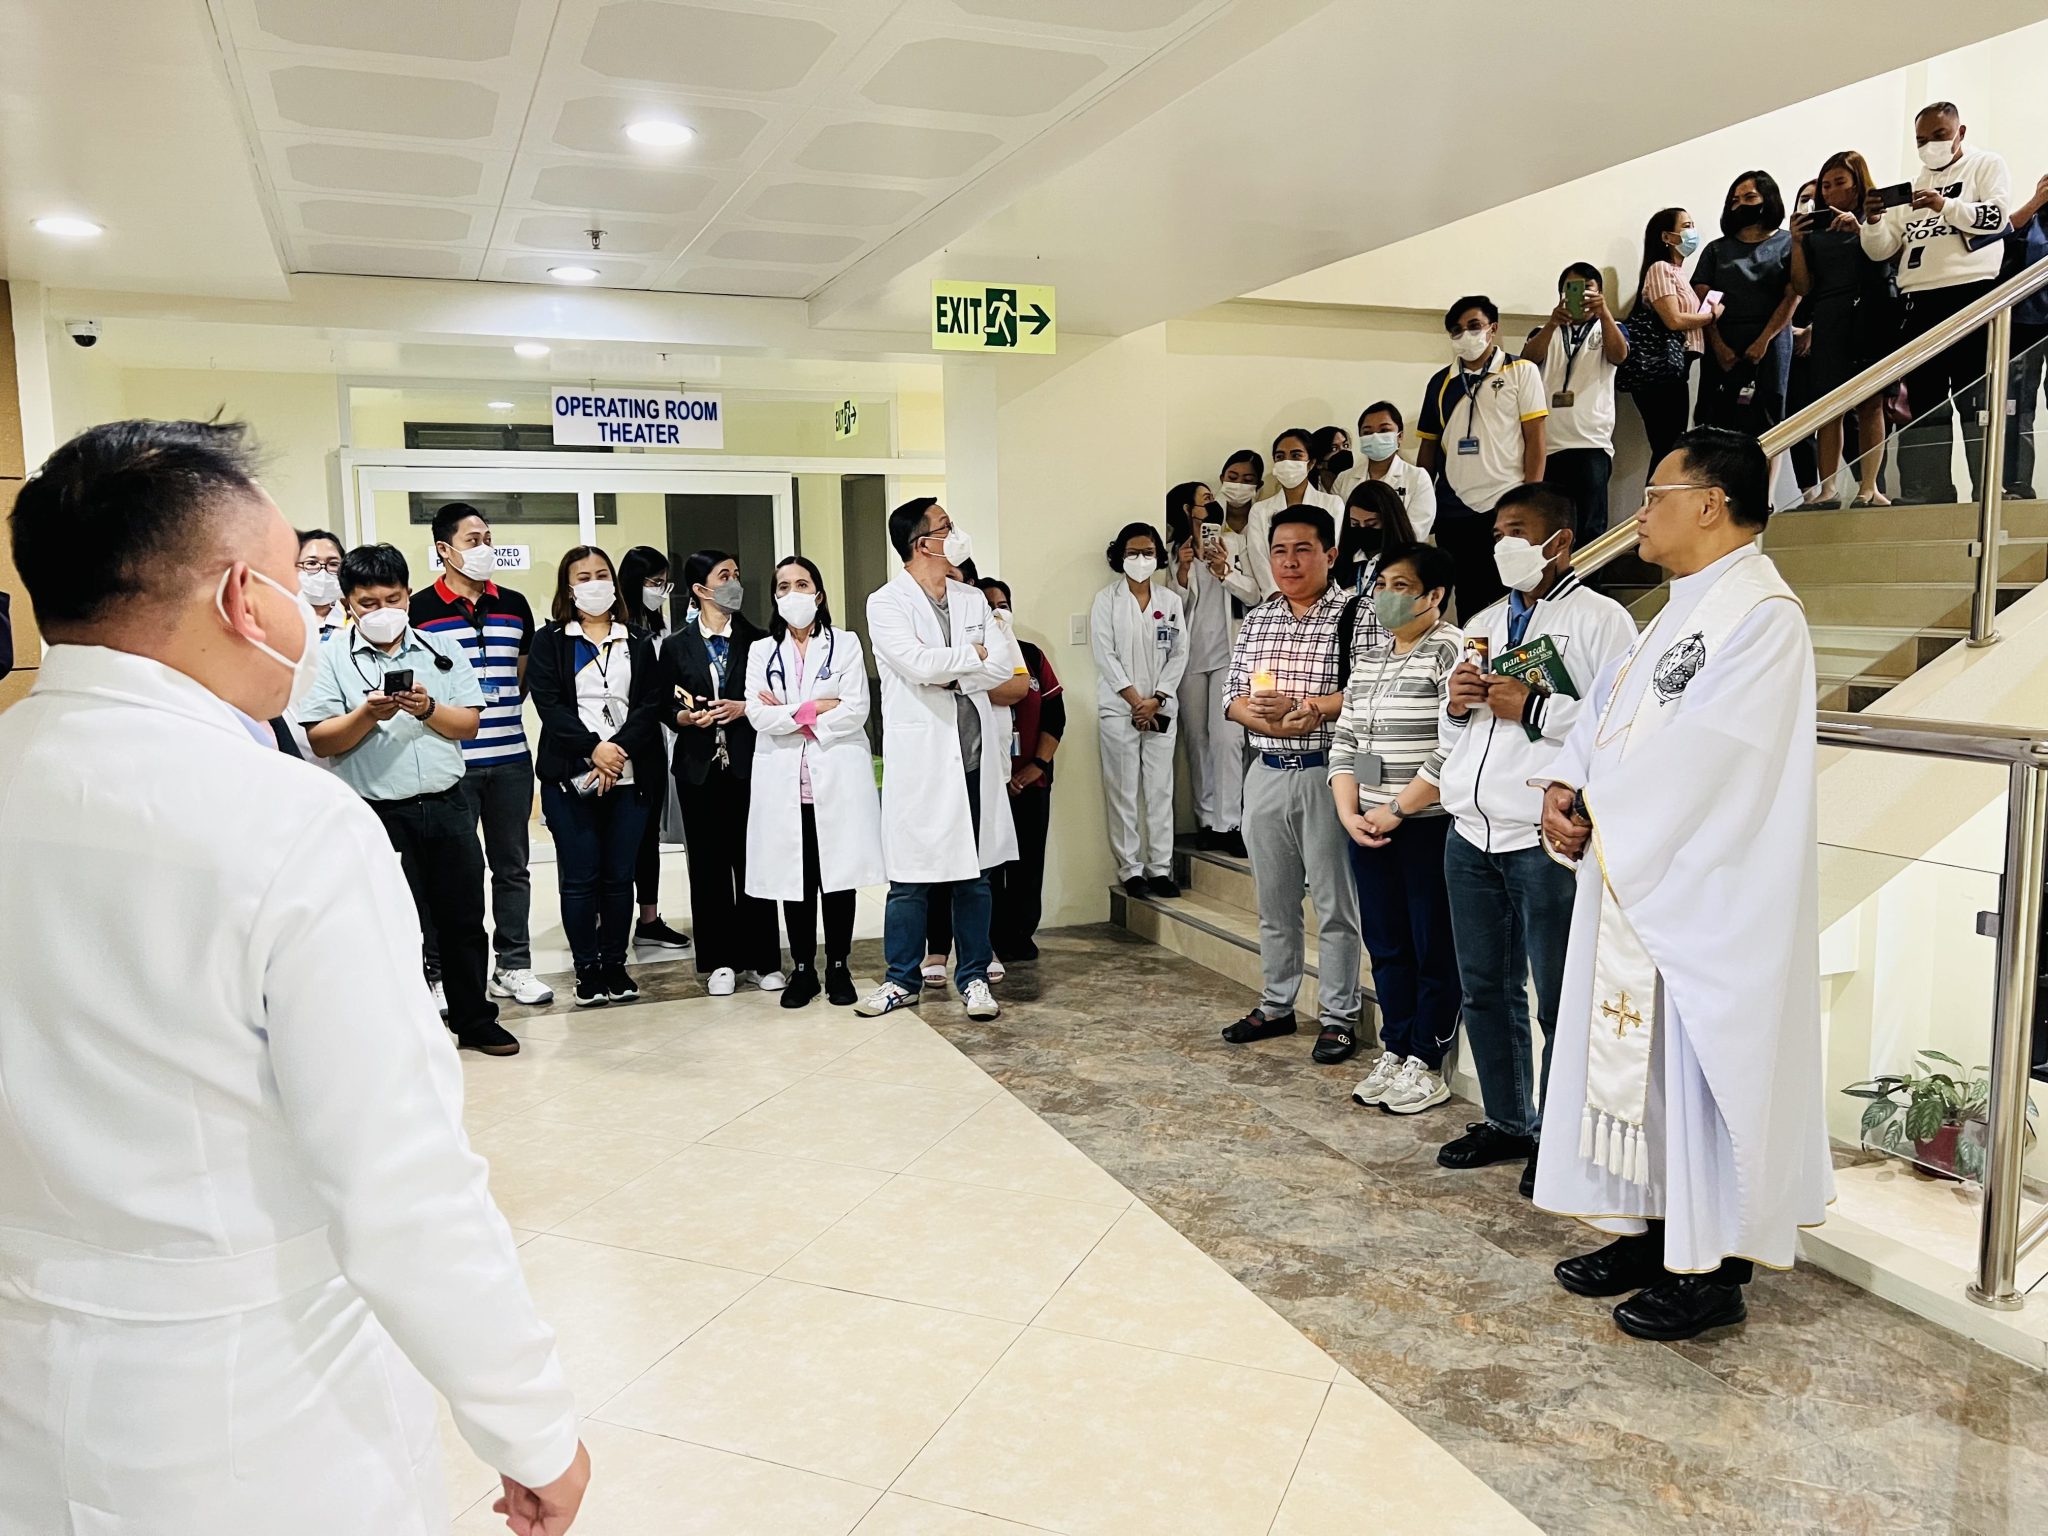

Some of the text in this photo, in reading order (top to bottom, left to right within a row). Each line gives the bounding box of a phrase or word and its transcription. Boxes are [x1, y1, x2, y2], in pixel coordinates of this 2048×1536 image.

[936, 296, 982, 334] EXIT
[555, 396, 718, 421] OPERATING ROOM
[598, 422, 680, 444] THEATER
[494, 548, 520, 557] RIZED
[496, 558, 521, 567] ONLY
